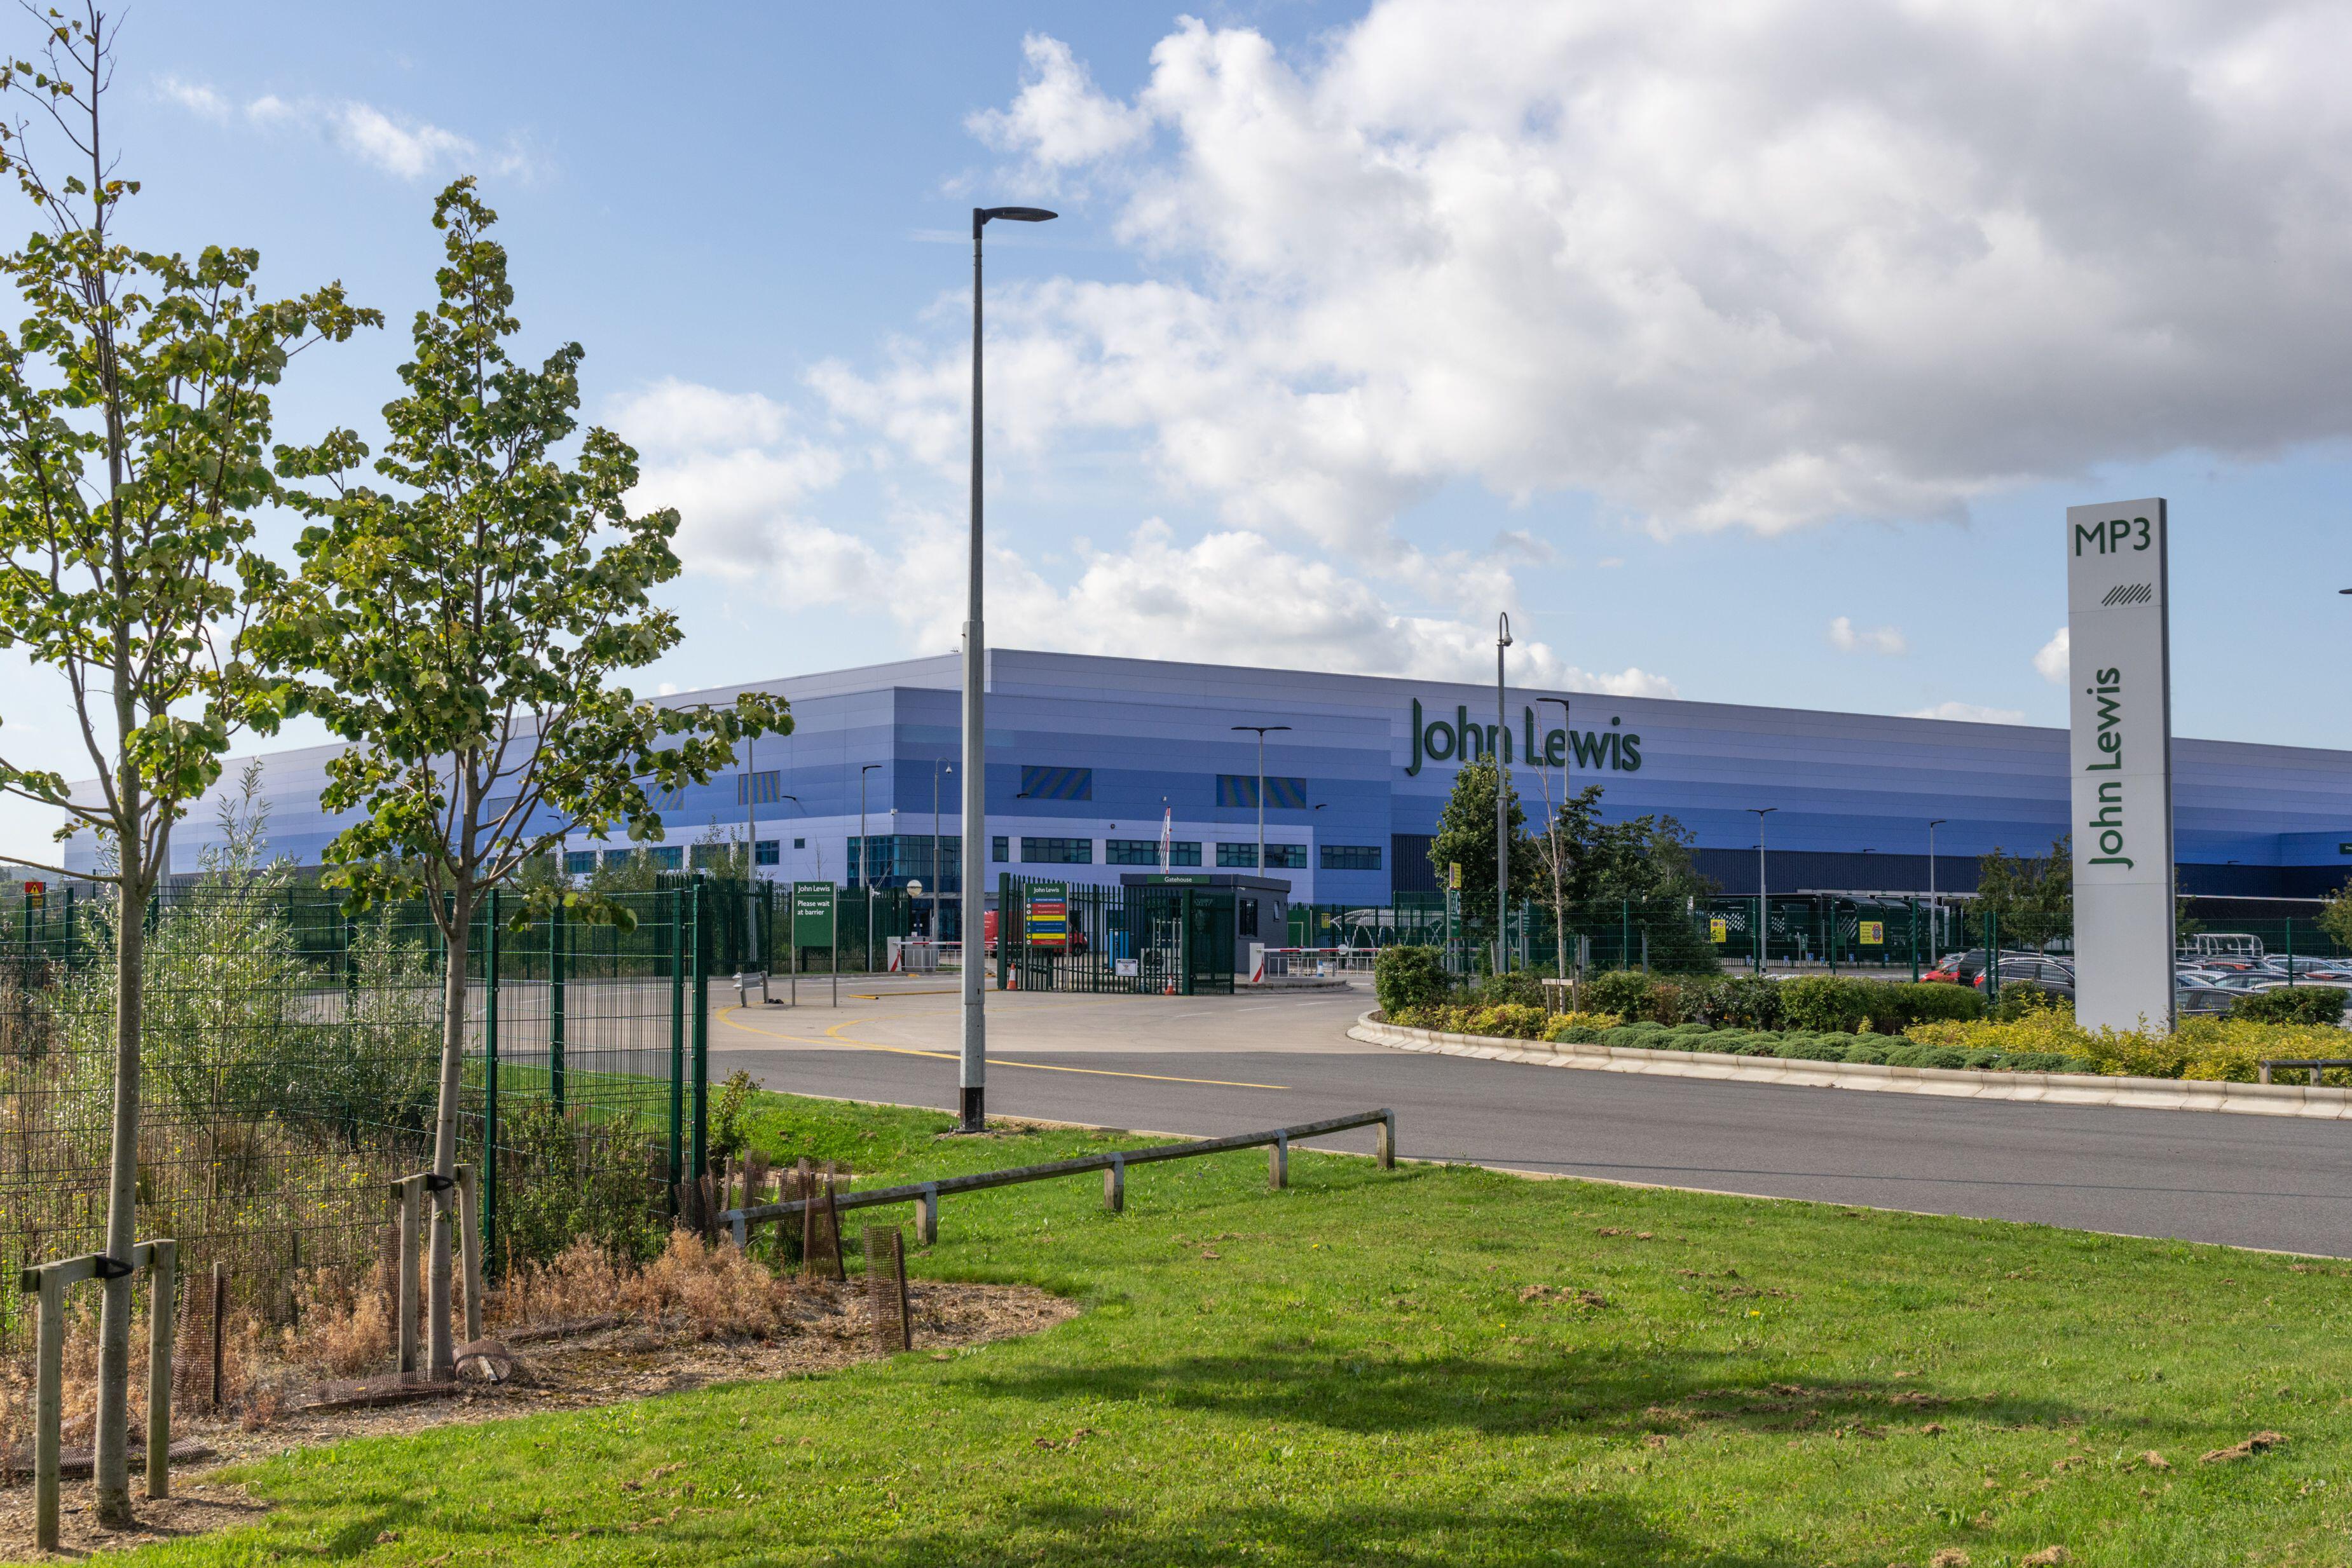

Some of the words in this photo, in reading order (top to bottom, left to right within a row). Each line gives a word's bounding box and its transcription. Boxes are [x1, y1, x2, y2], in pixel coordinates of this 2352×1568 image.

[2075, 517, 2150, 556] MP3
[1405, 697, 1512, 776] John
[1526, 706, 1641, 771] Lewis
[2086, 668, 2121, 770] Lewis
[2088, 782, 2134, 870] John
[798, 885, 812, 893] John
